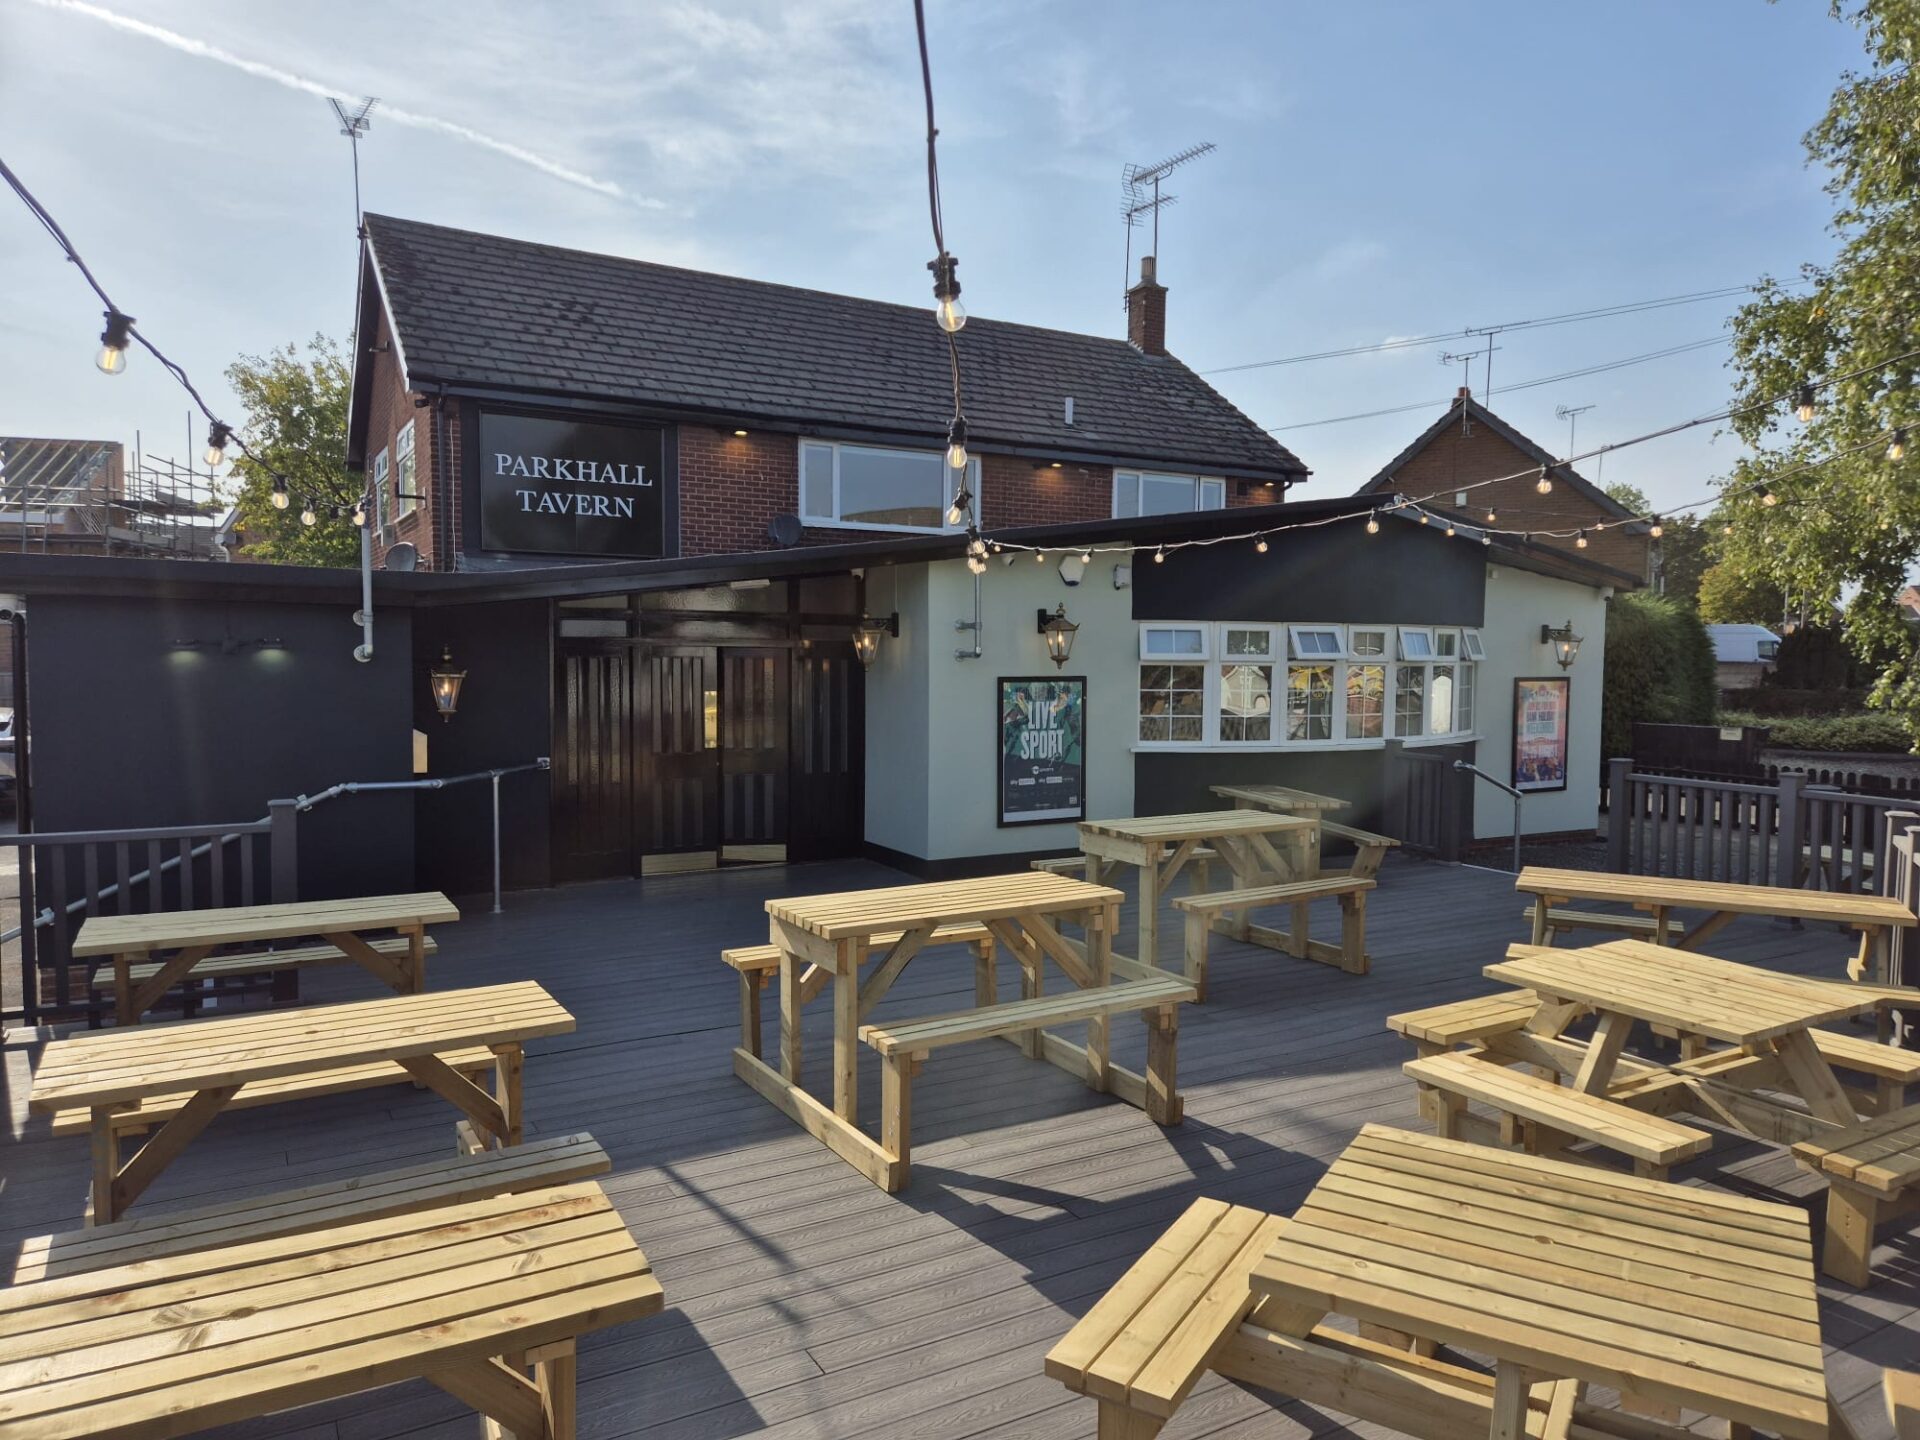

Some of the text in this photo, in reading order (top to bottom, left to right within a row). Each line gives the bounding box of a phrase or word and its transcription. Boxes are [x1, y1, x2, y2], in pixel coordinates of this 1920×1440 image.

[494, 453, 653, 487] PARKHALL
[516, 490, 635, 519] TAVERN
[1028, 701, 1058, 729] LIVE
[1020, 729, 1065, 760] SPORT
